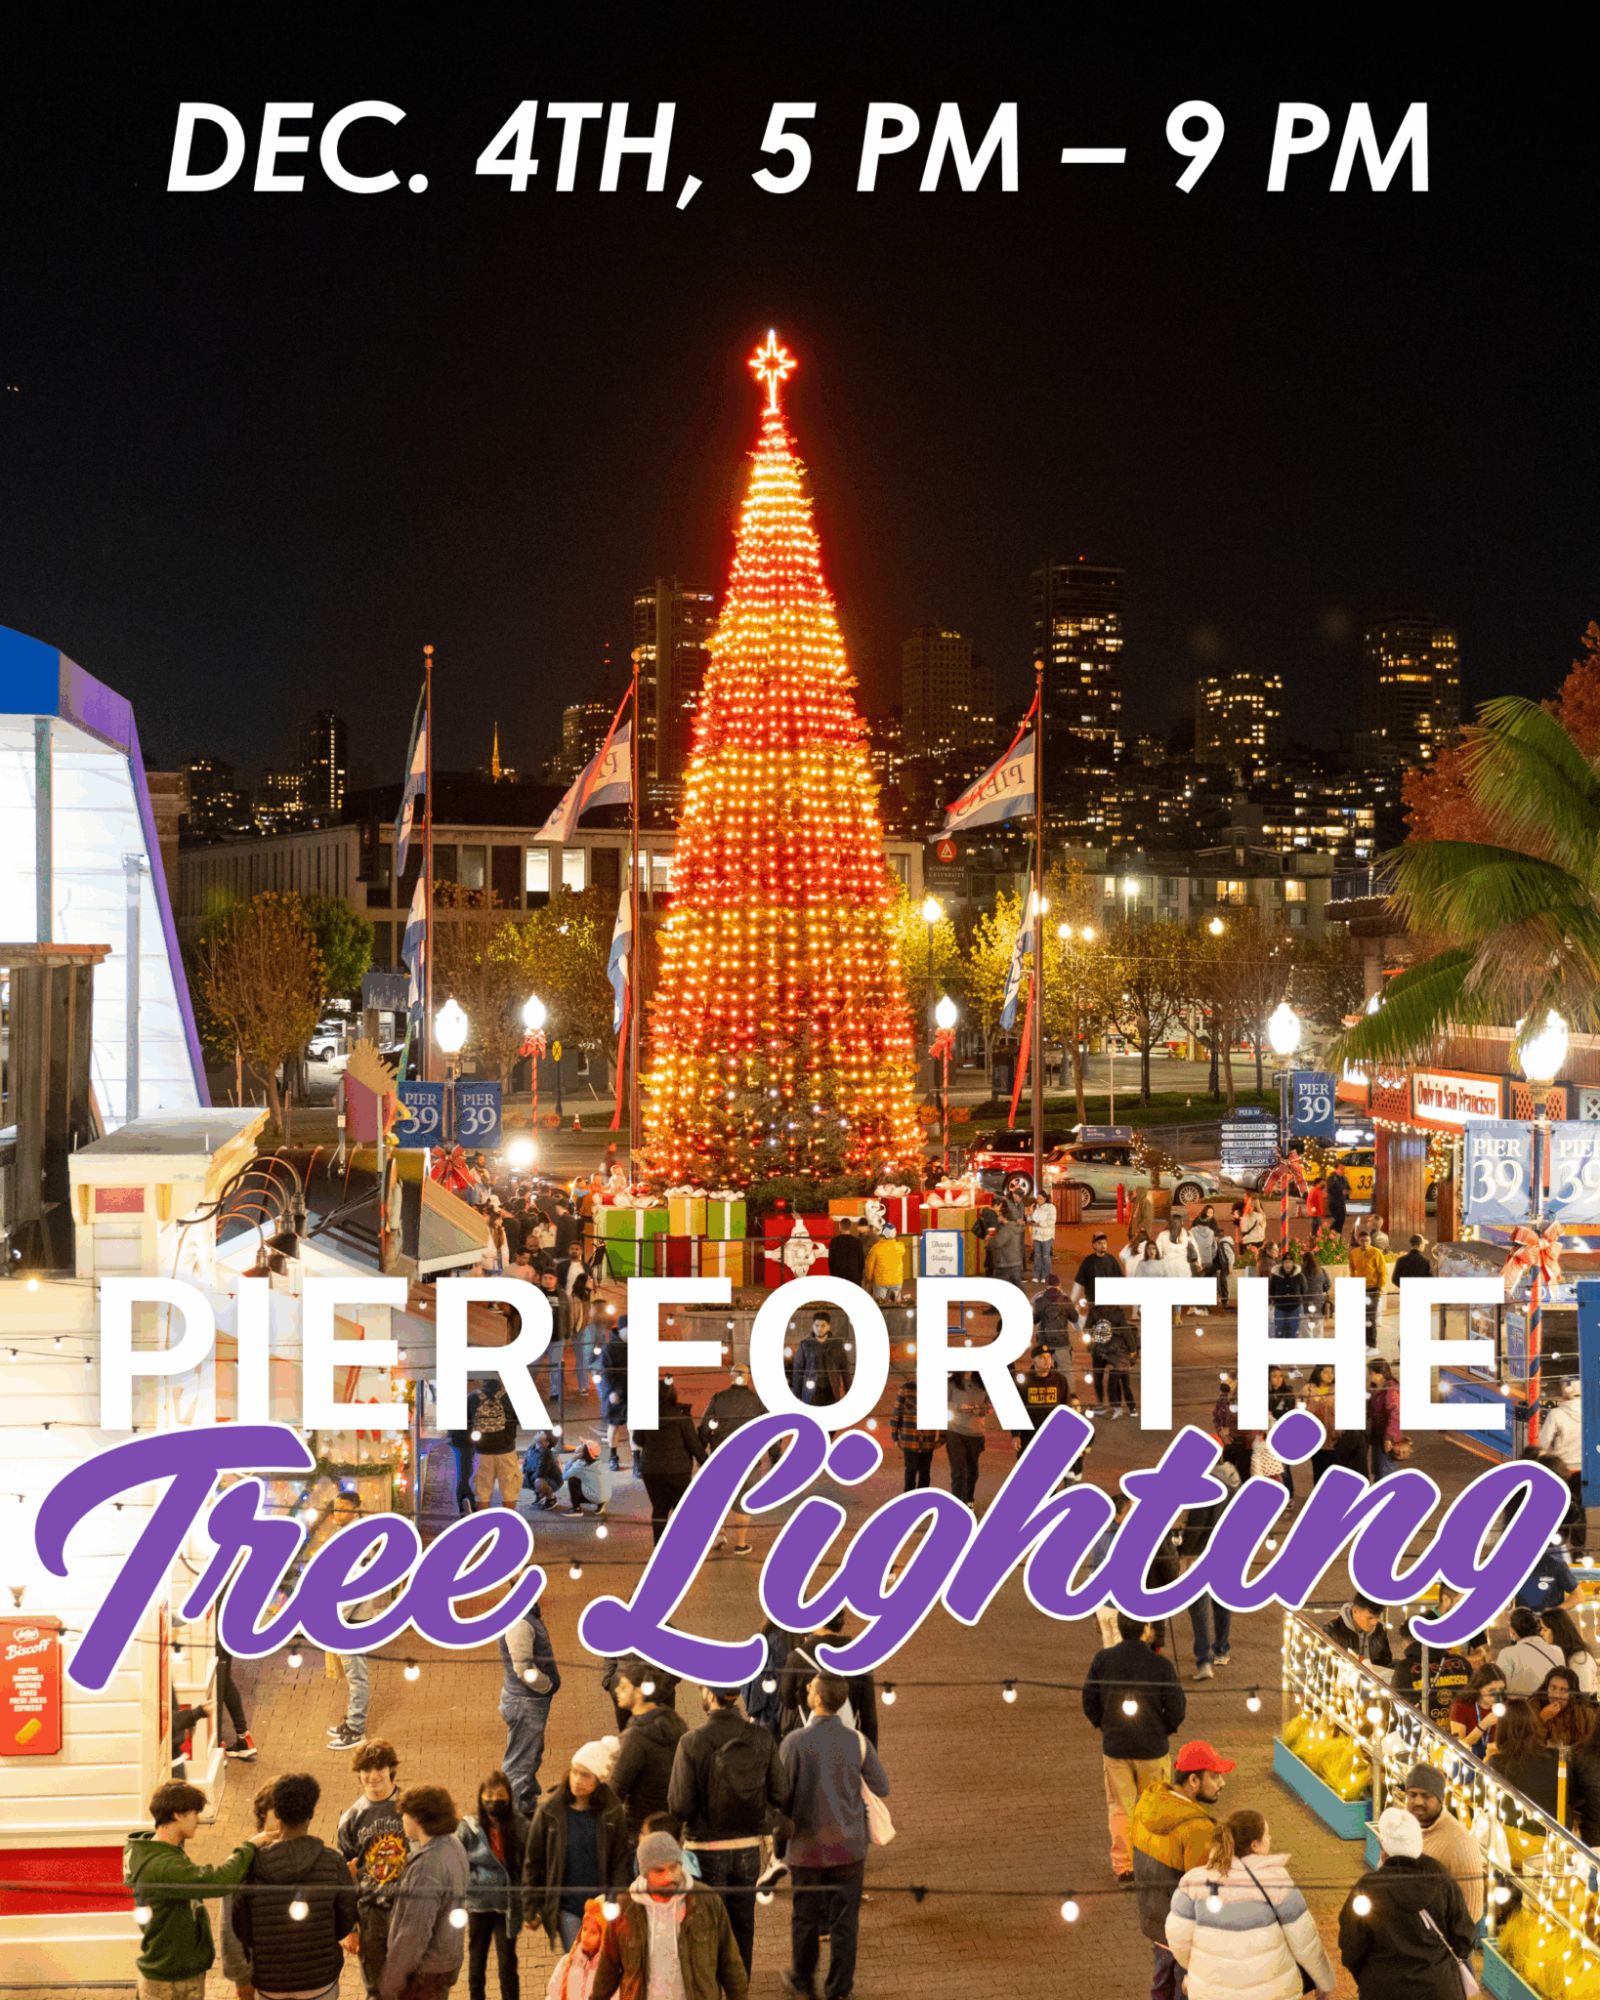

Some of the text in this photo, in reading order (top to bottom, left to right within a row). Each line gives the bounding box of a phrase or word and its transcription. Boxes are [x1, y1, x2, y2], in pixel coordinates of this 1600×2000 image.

[405, 1093, 437, 1106] PIER
[462, 1093, 495, 1106] PIER
[1299, 1083, 1330, 1096] PIER
[1417, 1080, 1496, 1115] Only in San Francisco
[402, 1106, 439, 1135] 39
[461, 1106, 498, 1135] 39
[1297, 1096, 1331, 1124] 39
[1473, 1138, 1523, 1158] PIER
[1357, 1175, 1374, 1190] 33
[1470, 1159, 1524, 1203] 39
[1555, 1159, 1600, 1204] 39
[5, 1638, 52, 1660] Biscoff
